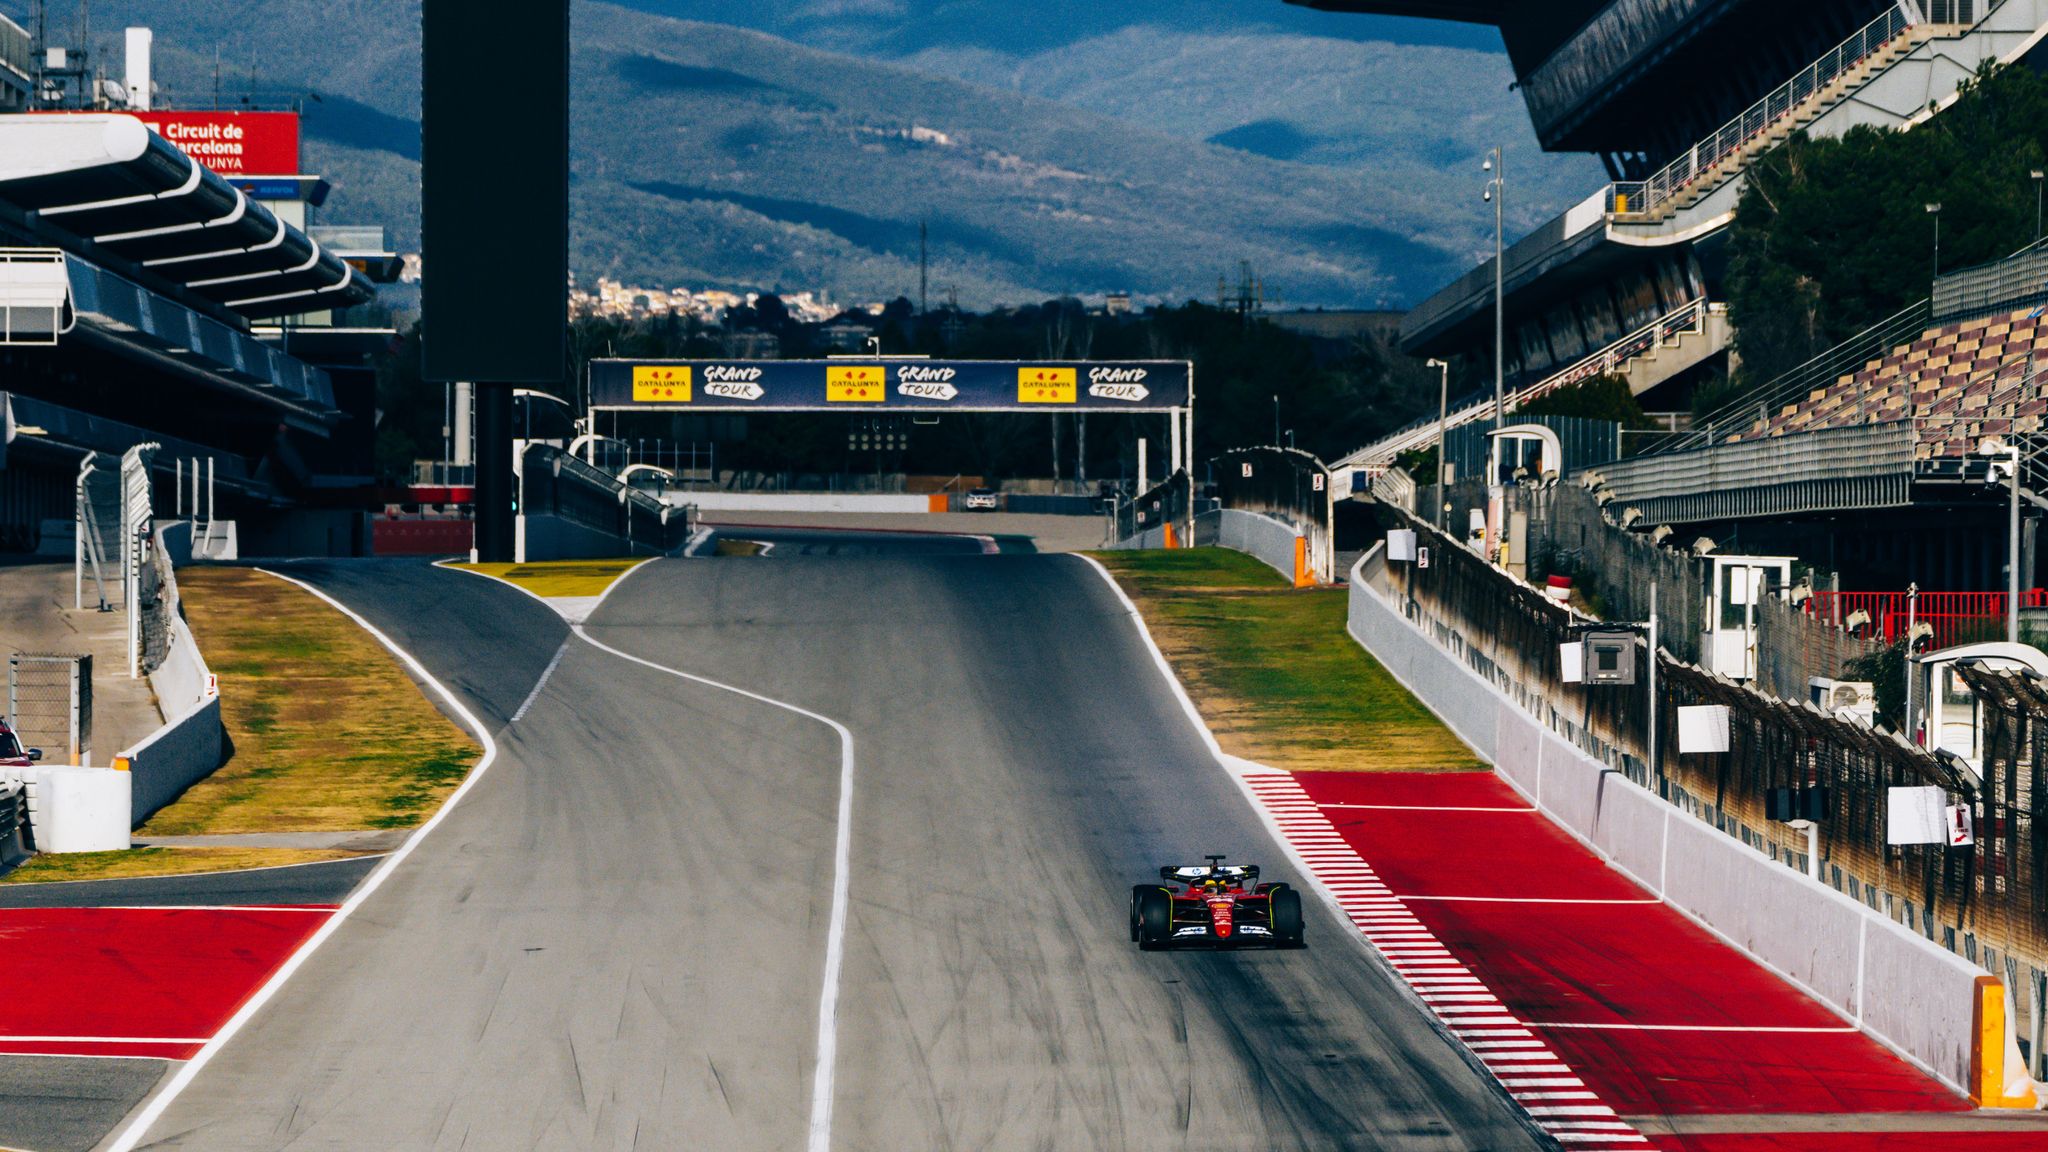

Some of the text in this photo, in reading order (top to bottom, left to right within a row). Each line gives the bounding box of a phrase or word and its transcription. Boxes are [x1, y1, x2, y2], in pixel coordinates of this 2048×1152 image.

[167, 122, 243, 139] Circuit de
[703, 365, 762, 382] GRAND
[897, 365, 956, 382] GRAND
[1088, 367, 1147, 384] GRAND
[712, 384, 753, 397] TOUR
[905, 384, 947, 397] TOUR
[1096, 385, 1139, 398] TOUR
